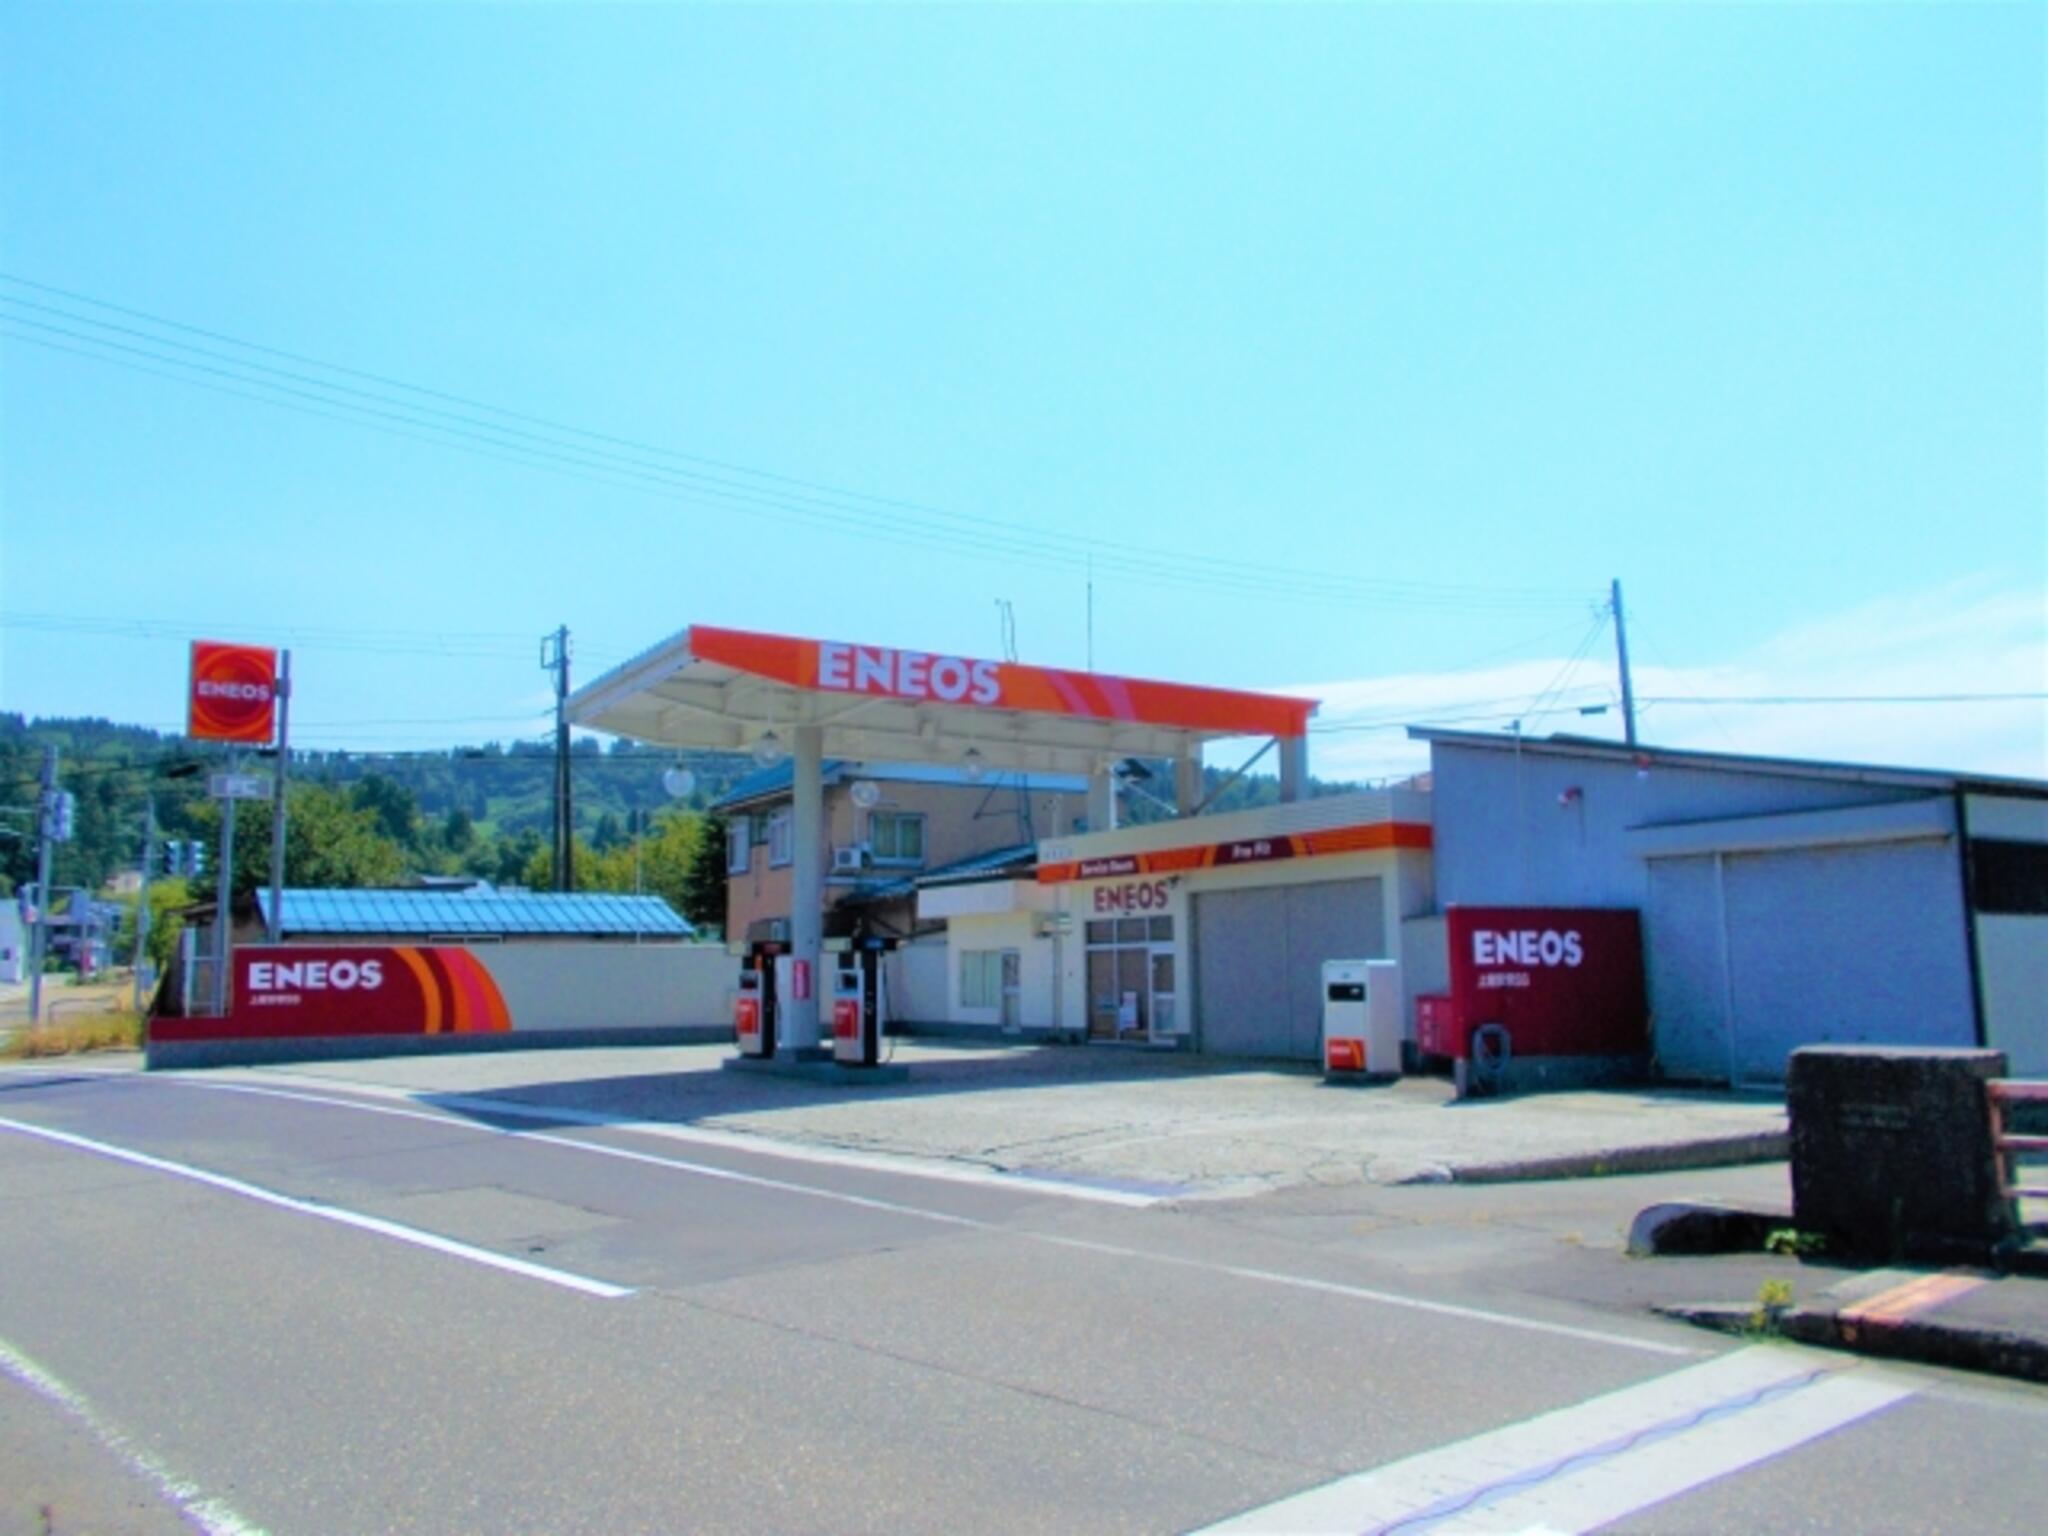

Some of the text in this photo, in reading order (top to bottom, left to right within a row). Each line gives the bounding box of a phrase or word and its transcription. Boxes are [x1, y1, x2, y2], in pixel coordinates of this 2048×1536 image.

[817, 643, 1000, 704] ENEOS
[197, 681, 270, 700] ENEOS
[1094, 882, 1167, 912] ENEOS
[1474, 930, 1583, 967] ENEOS
[249, 961, 382, 989] ENEOS
